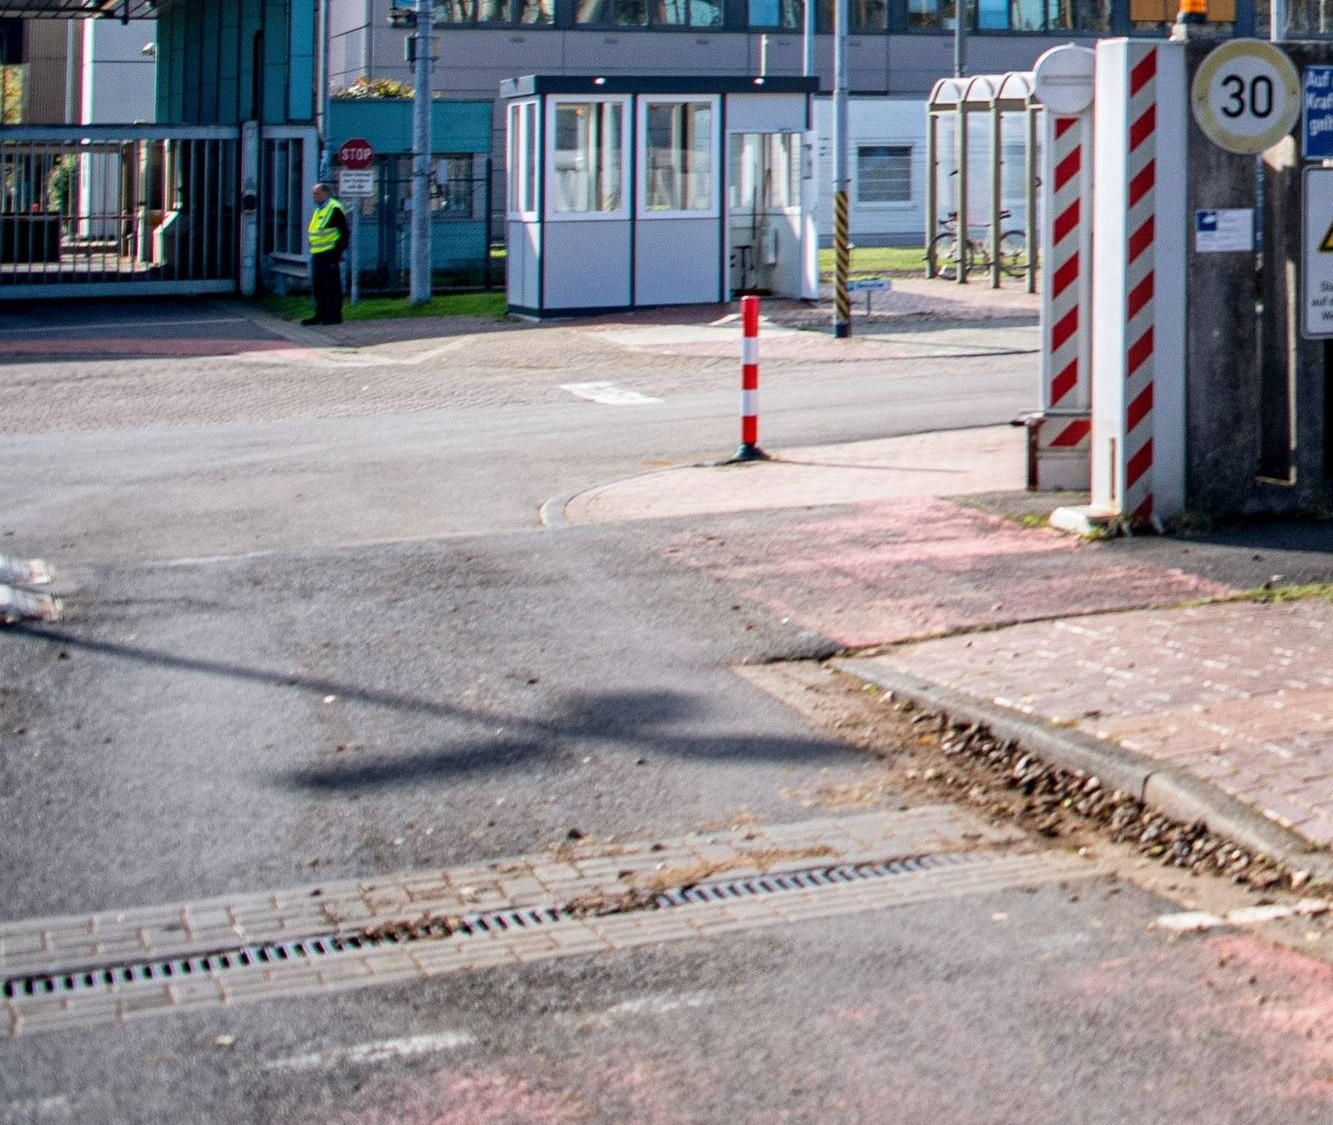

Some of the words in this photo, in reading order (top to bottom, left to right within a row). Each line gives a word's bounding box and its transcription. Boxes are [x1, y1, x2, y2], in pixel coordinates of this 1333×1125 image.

[1306, 71, 1331, 88] Auf
[1221, 74, 1273, 118] 30
[342, 148, 372, 161] STOP
